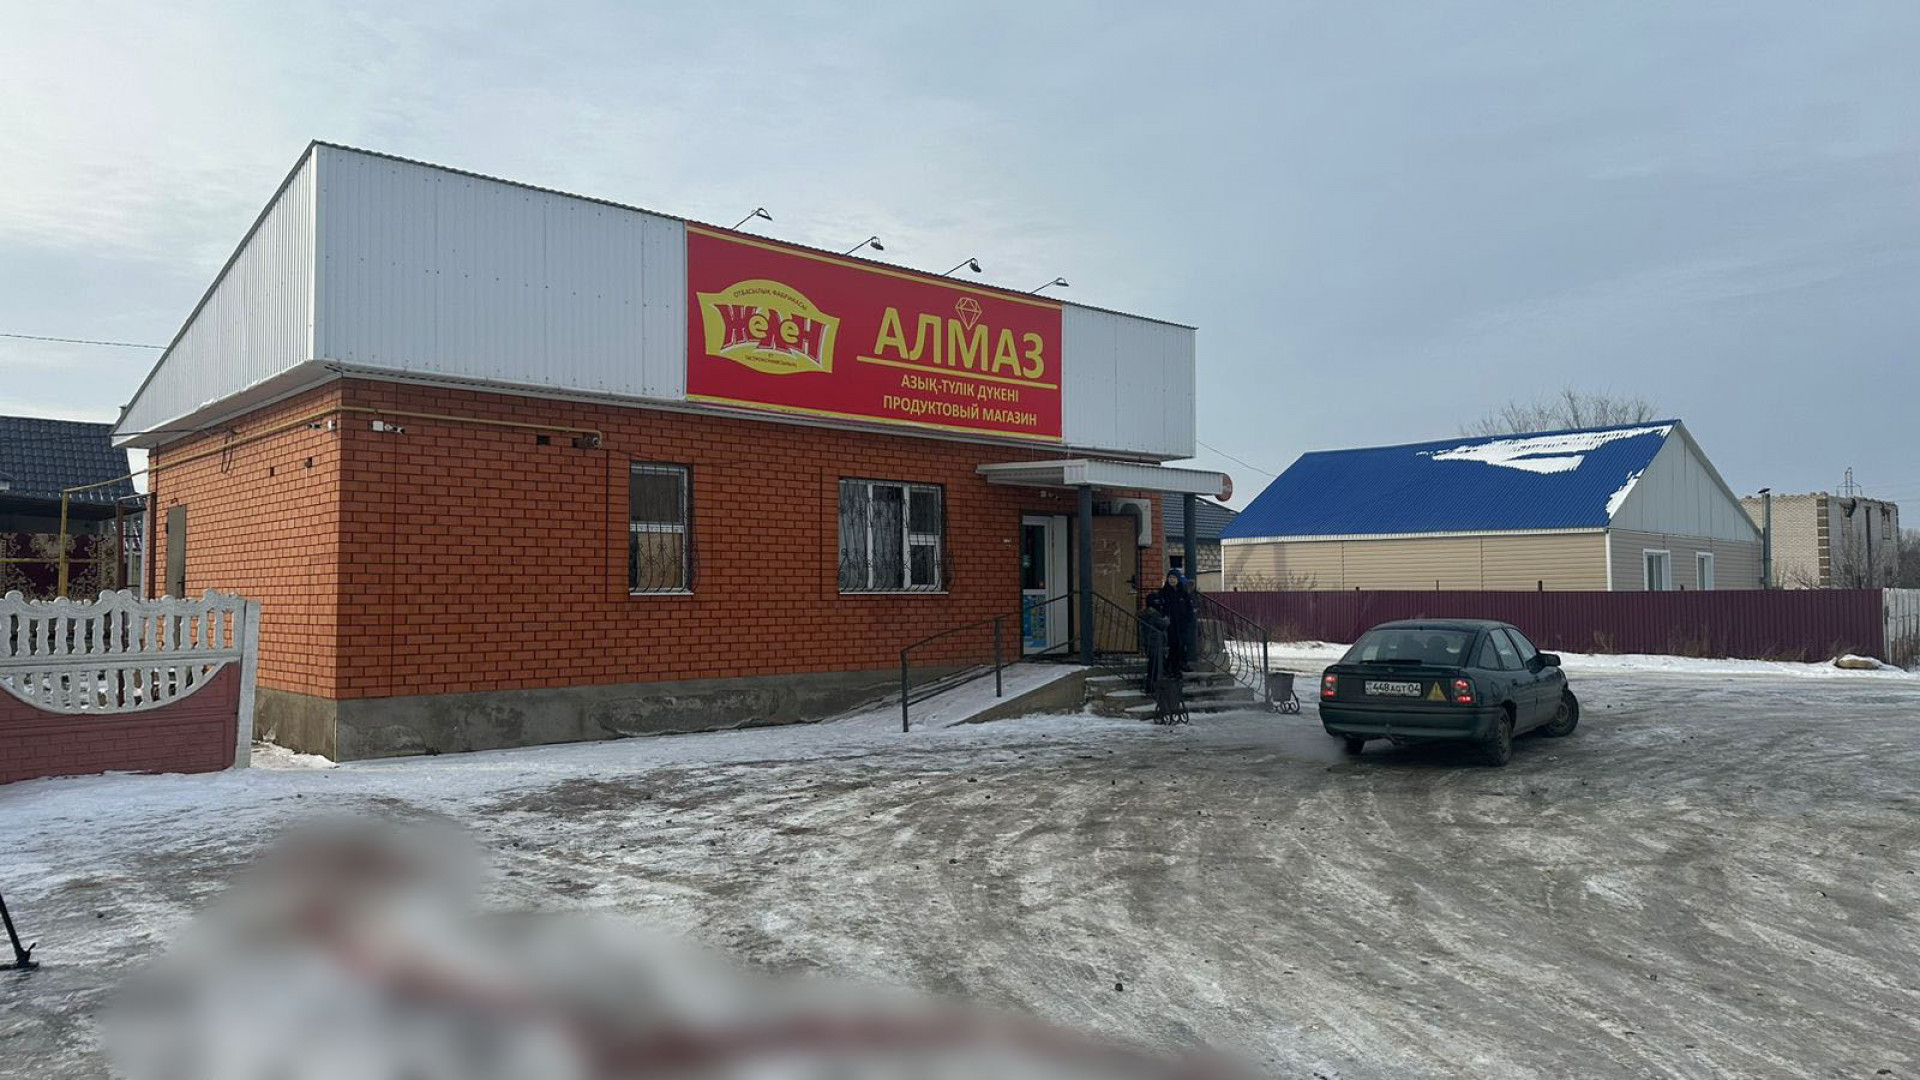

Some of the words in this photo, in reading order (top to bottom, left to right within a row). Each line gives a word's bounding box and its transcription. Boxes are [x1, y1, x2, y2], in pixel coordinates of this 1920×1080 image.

[874, 306, 1045, 379] АЛМАЗ
[901, 374, 975, 397] АЗЫҚ-ТҮЛІК
[977, 385, 1019, 402] ДҮКЕНІ
[883, 395, 979, 420] ПРОДУКТОВЫЙ
[982, 407, 1037, 426] МАГАЗИН
